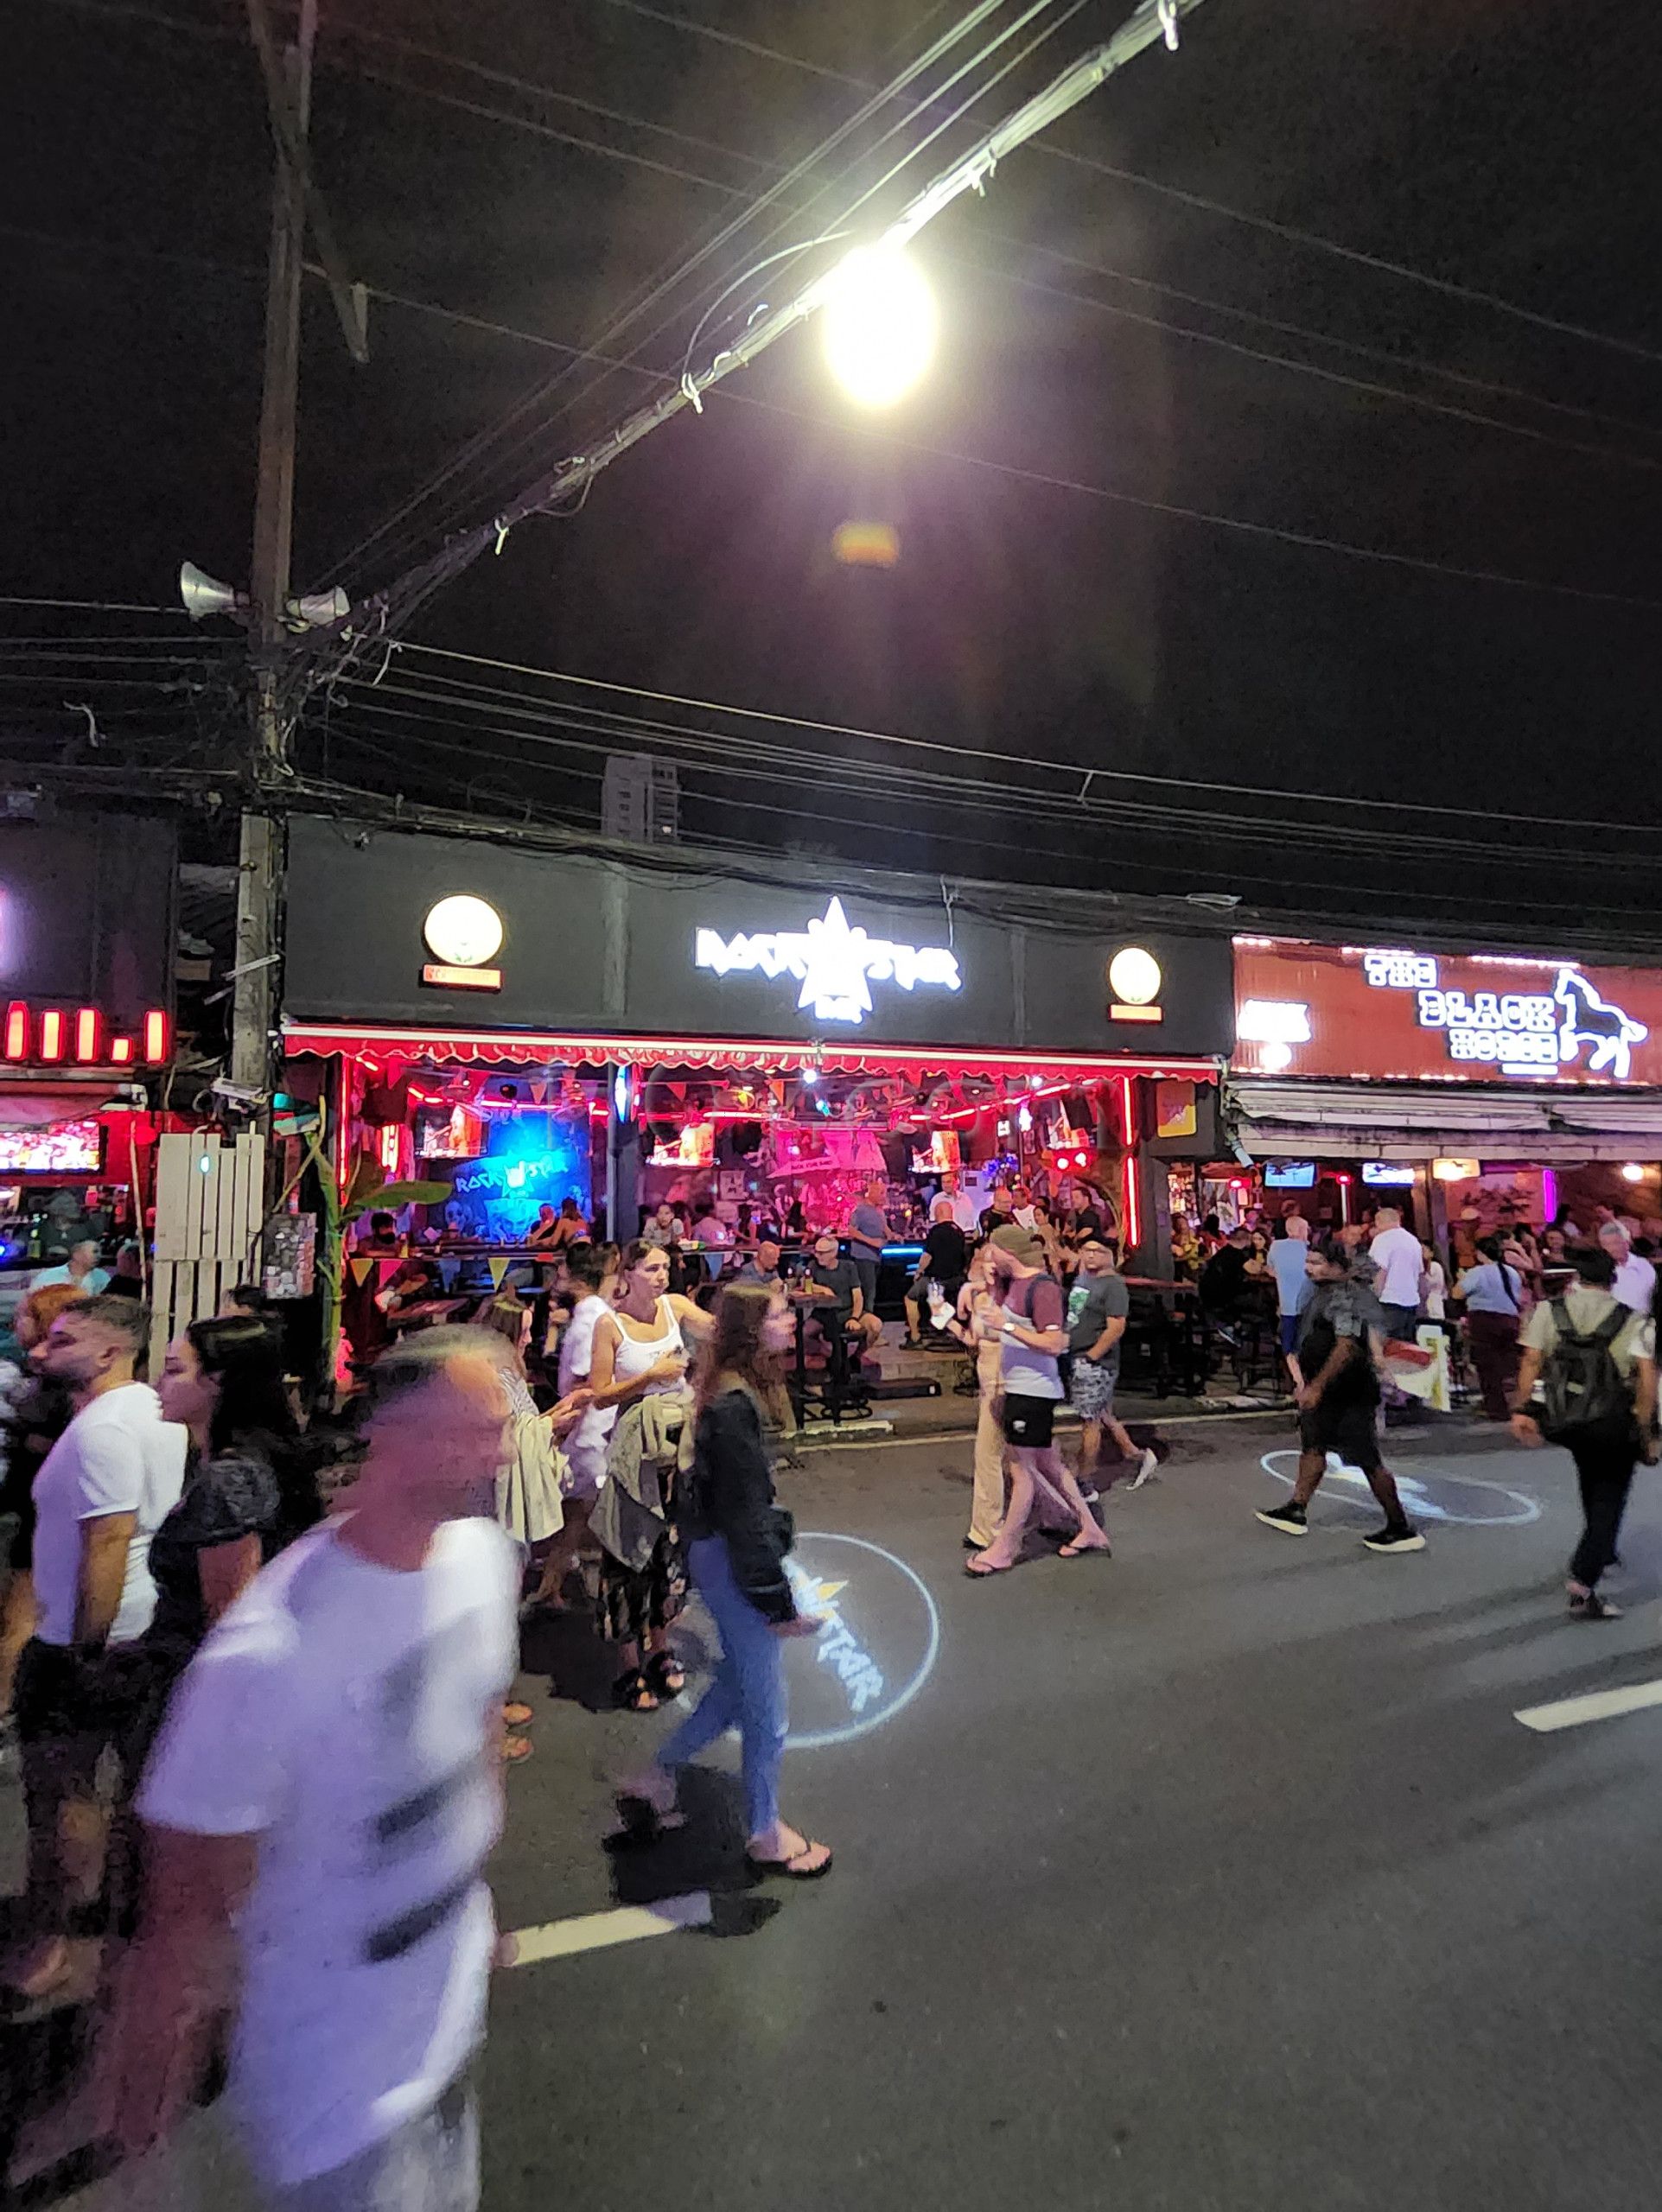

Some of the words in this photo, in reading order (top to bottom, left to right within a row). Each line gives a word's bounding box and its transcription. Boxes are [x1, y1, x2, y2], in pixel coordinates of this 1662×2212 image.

[1365, 955, 1436, 988] THE
[1418, 990, 1556, 1032] BLACK
[455, 1170, 504, 1192] ROCK
